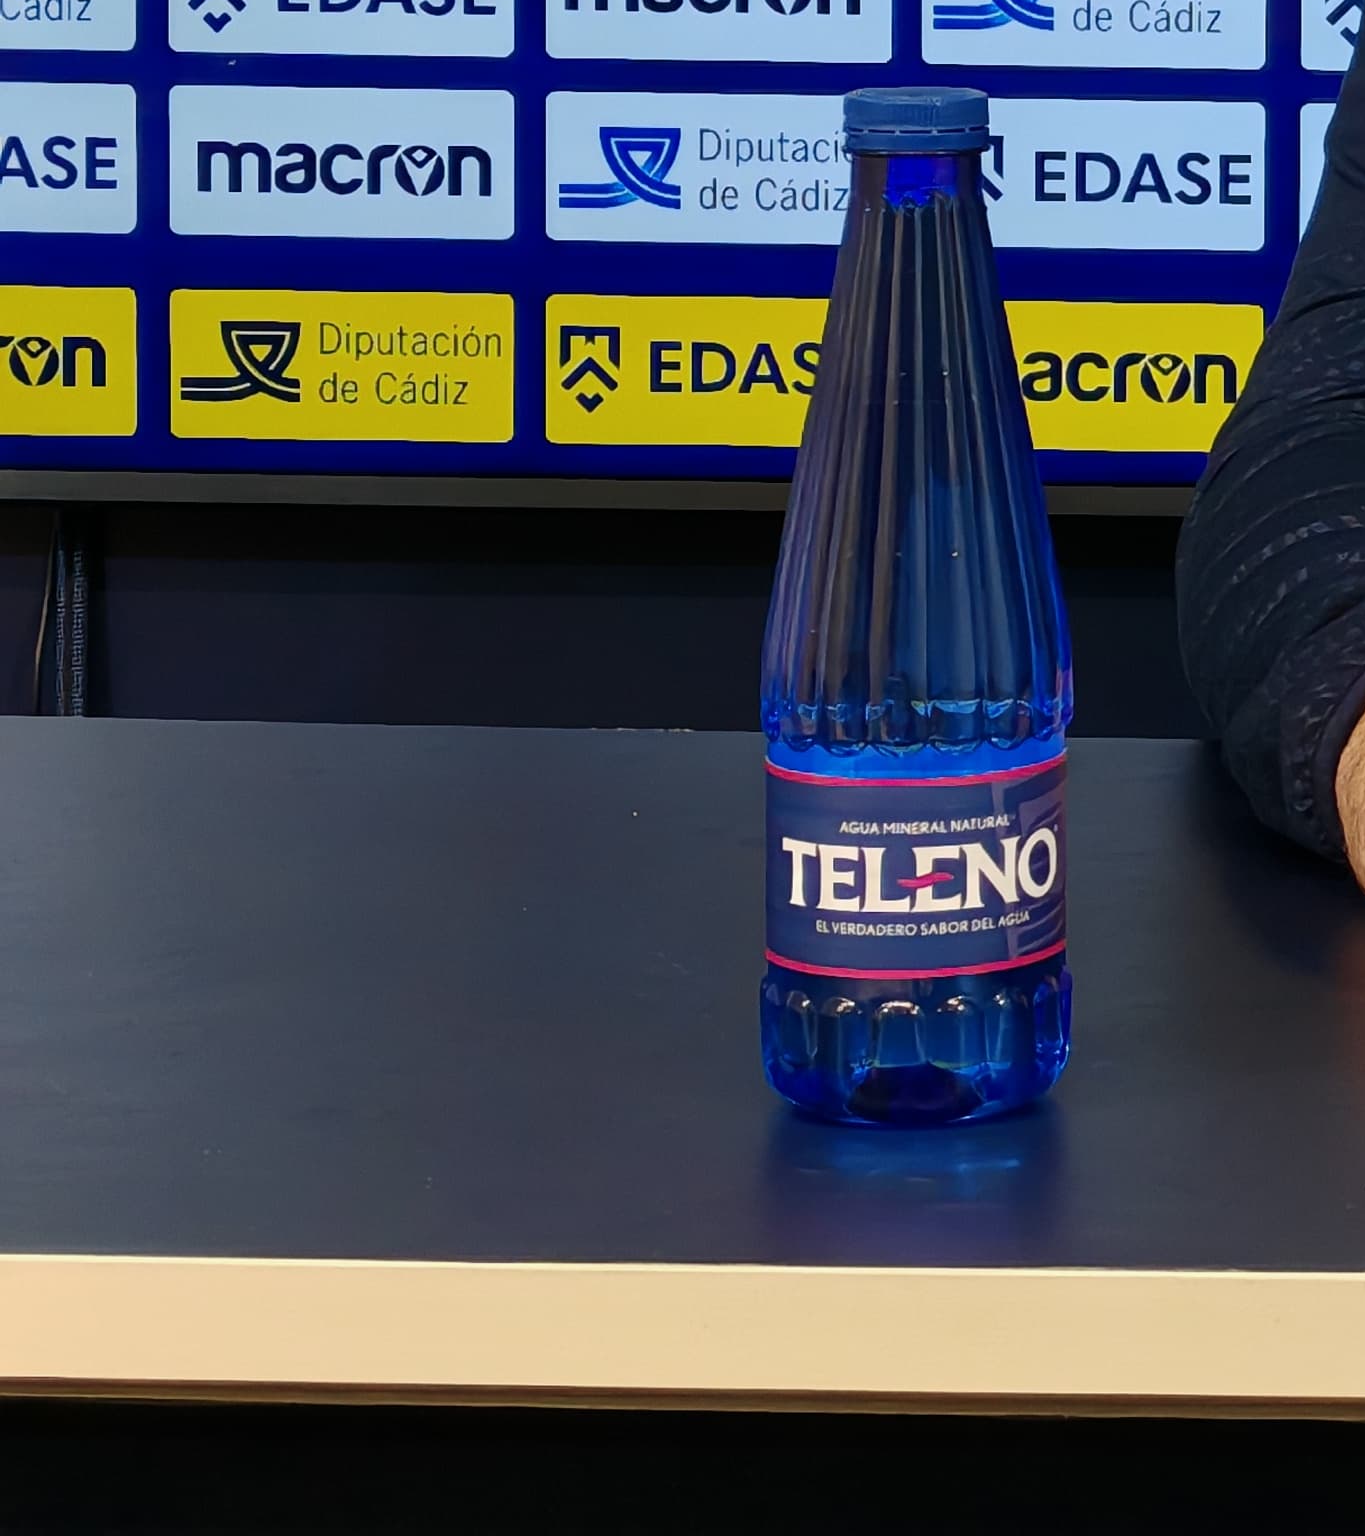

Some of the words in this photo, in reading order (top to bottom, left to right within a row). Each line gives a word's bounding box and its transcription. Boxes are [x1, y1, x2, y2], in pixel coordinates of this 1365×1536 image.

[1072, 0, 1113, 33] de
[1129, 0, 1222, 34] Cádiz
[0, 135, 118, 190] ASE
[699, 127, 852, 168] Diputaci
[197, 140, 492, 197] macron
[1034, 151, 1252, 206] EDASE
[699, 177, 739, 211] de
[755, 177, 850, 213] Cádiz
[319, 321, 502, 362] Diputación
[318, 371, 358, 405] de
[375, 371, 469, 405] Cádiz
[649, 340, 820, 396] EDAS
[1021, 350, 1239, 405] acron
[839, 820, 880, 835] AGUA
[882, 820, 947, 835] MINERAL
[950, 814, 1010, 833] NATURAL
[782, 827, 1057, 913] TELENO
[815, 919, 829, 934] EL
[831, 921, 917, 937] VERDADERO
[920, 920, 969, 936] SABOR
[971, 918, 997, 932] DEL
[998, 910, 1030, 928] AGUA
